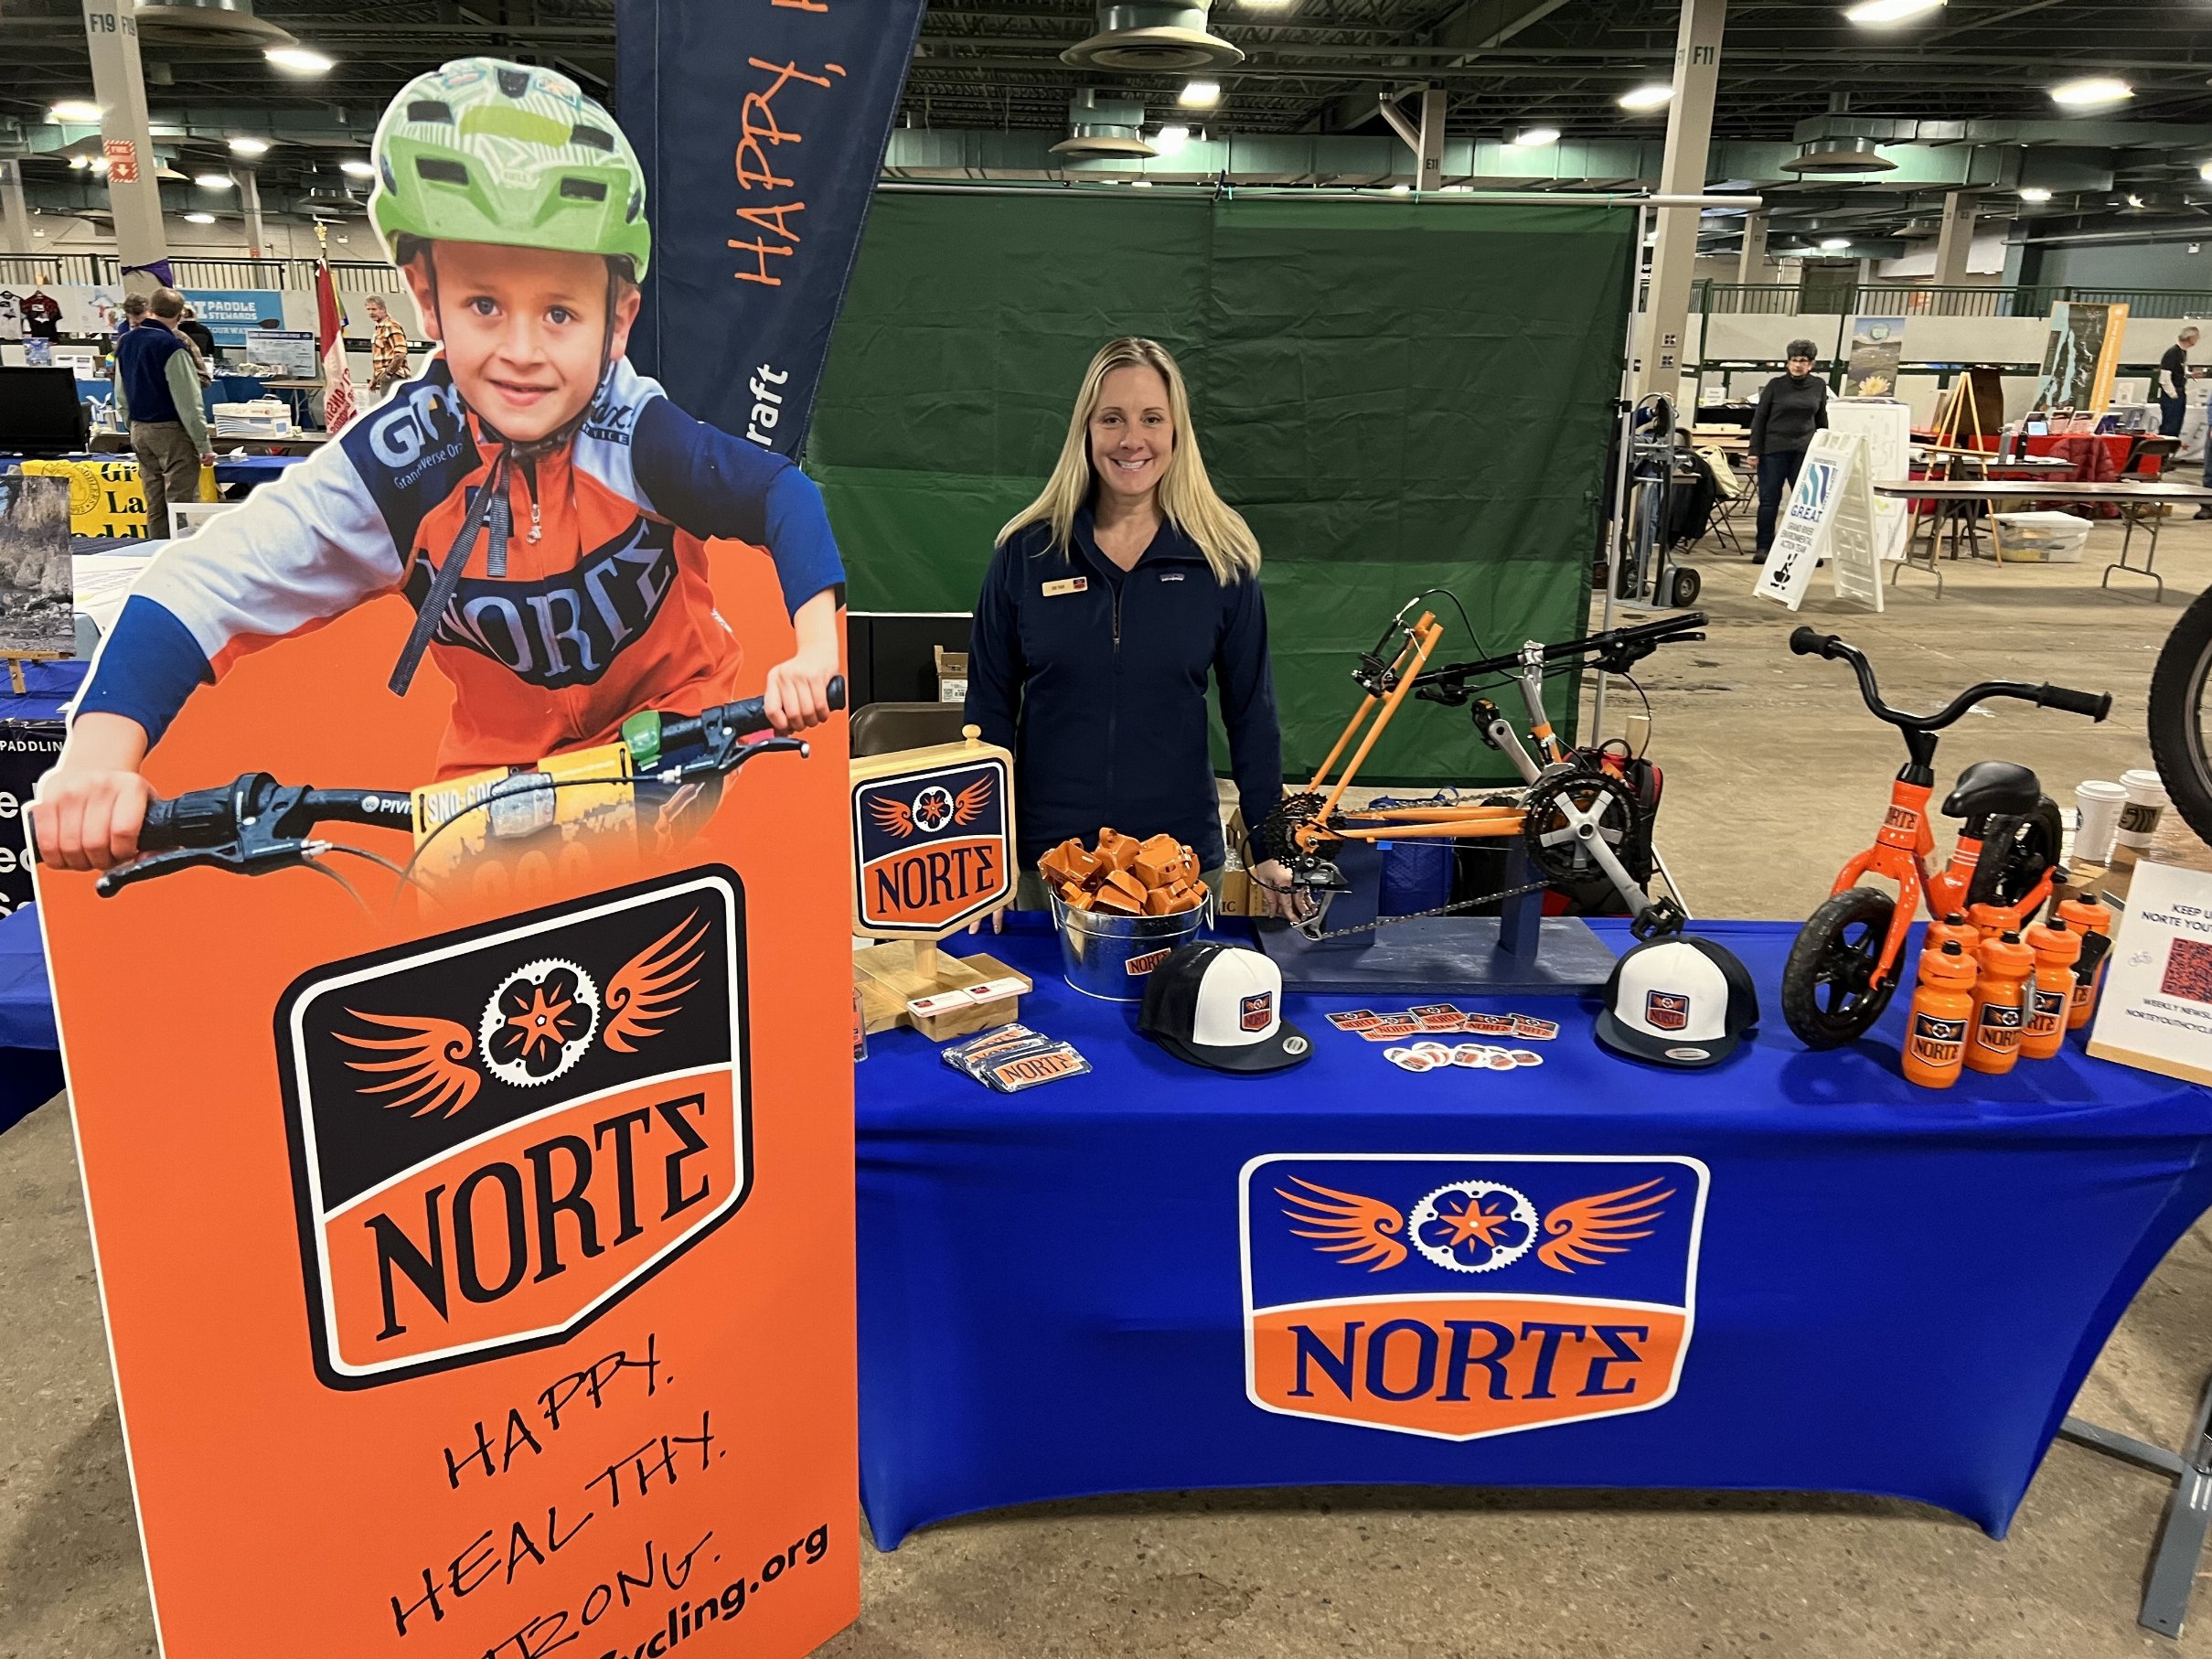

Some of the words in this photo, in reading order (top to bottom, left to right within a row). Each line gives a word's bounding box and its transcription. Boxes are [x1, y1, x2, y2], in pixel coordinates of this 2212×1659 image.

[90, 14, 115, 33] F19
[1693, 46, 1715, 65] F11
[1426, 158, 1438, 170] E11
[208, 301, 256, 312] PADDLE
[208, 312, 257, 320] STEWARDS
[746, 363, 788, 450] raft
[101, 463, 143, 483] Gr
[2142, 911, 2182, 926] NORTE
[2172, 904, 2202, 915] KEEP
[443, 1333, 675, 1490] HAPPY.
[390, 1410, 728, 1637] HEALTHY.
[481, 1531, 722, 1659] TRONG.
